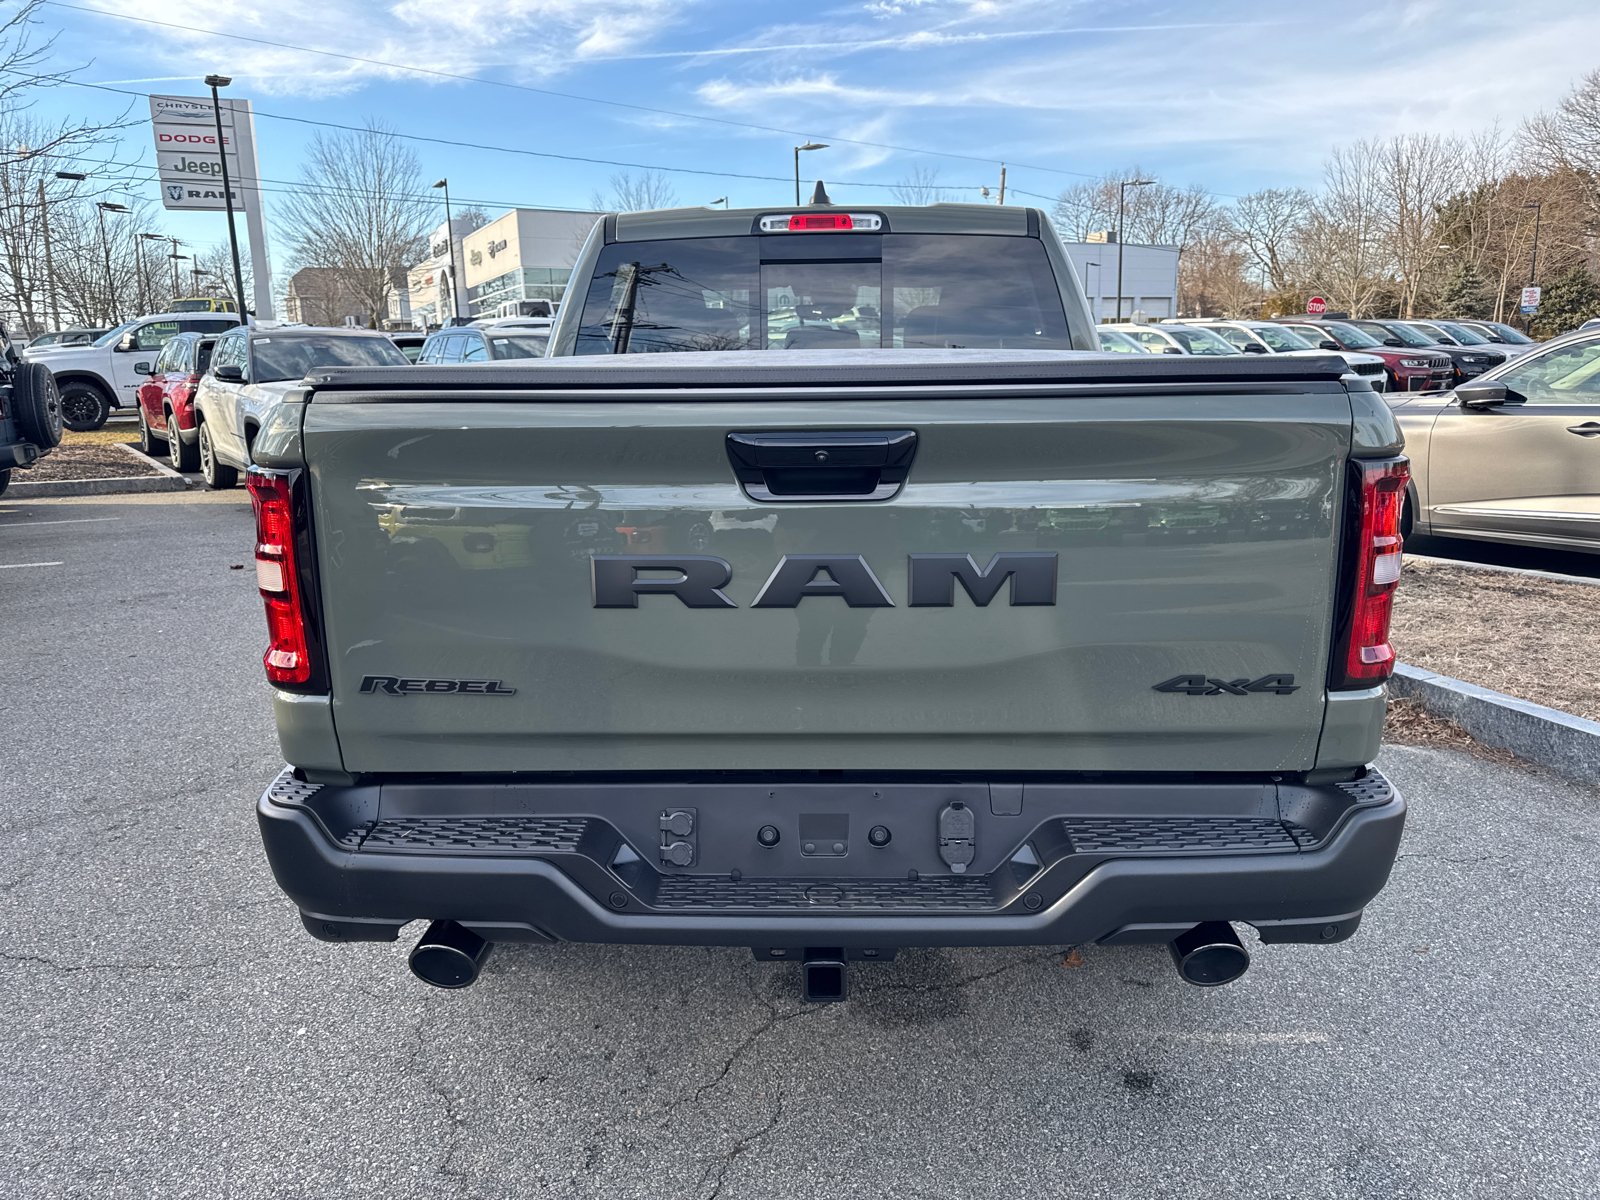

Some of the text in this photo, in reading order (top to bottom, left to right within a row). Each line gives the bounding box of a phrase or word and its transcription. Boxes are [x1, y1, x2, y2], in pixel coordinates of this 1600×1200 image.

[174, 157, 222, 176] Jeep
[1308, 302, 1326, 313] STOP
[589, 551, 1059, 609] RAM
[358, 674, 517, 697] REBEL
[1151, 673, 1302, 696] 4x4
